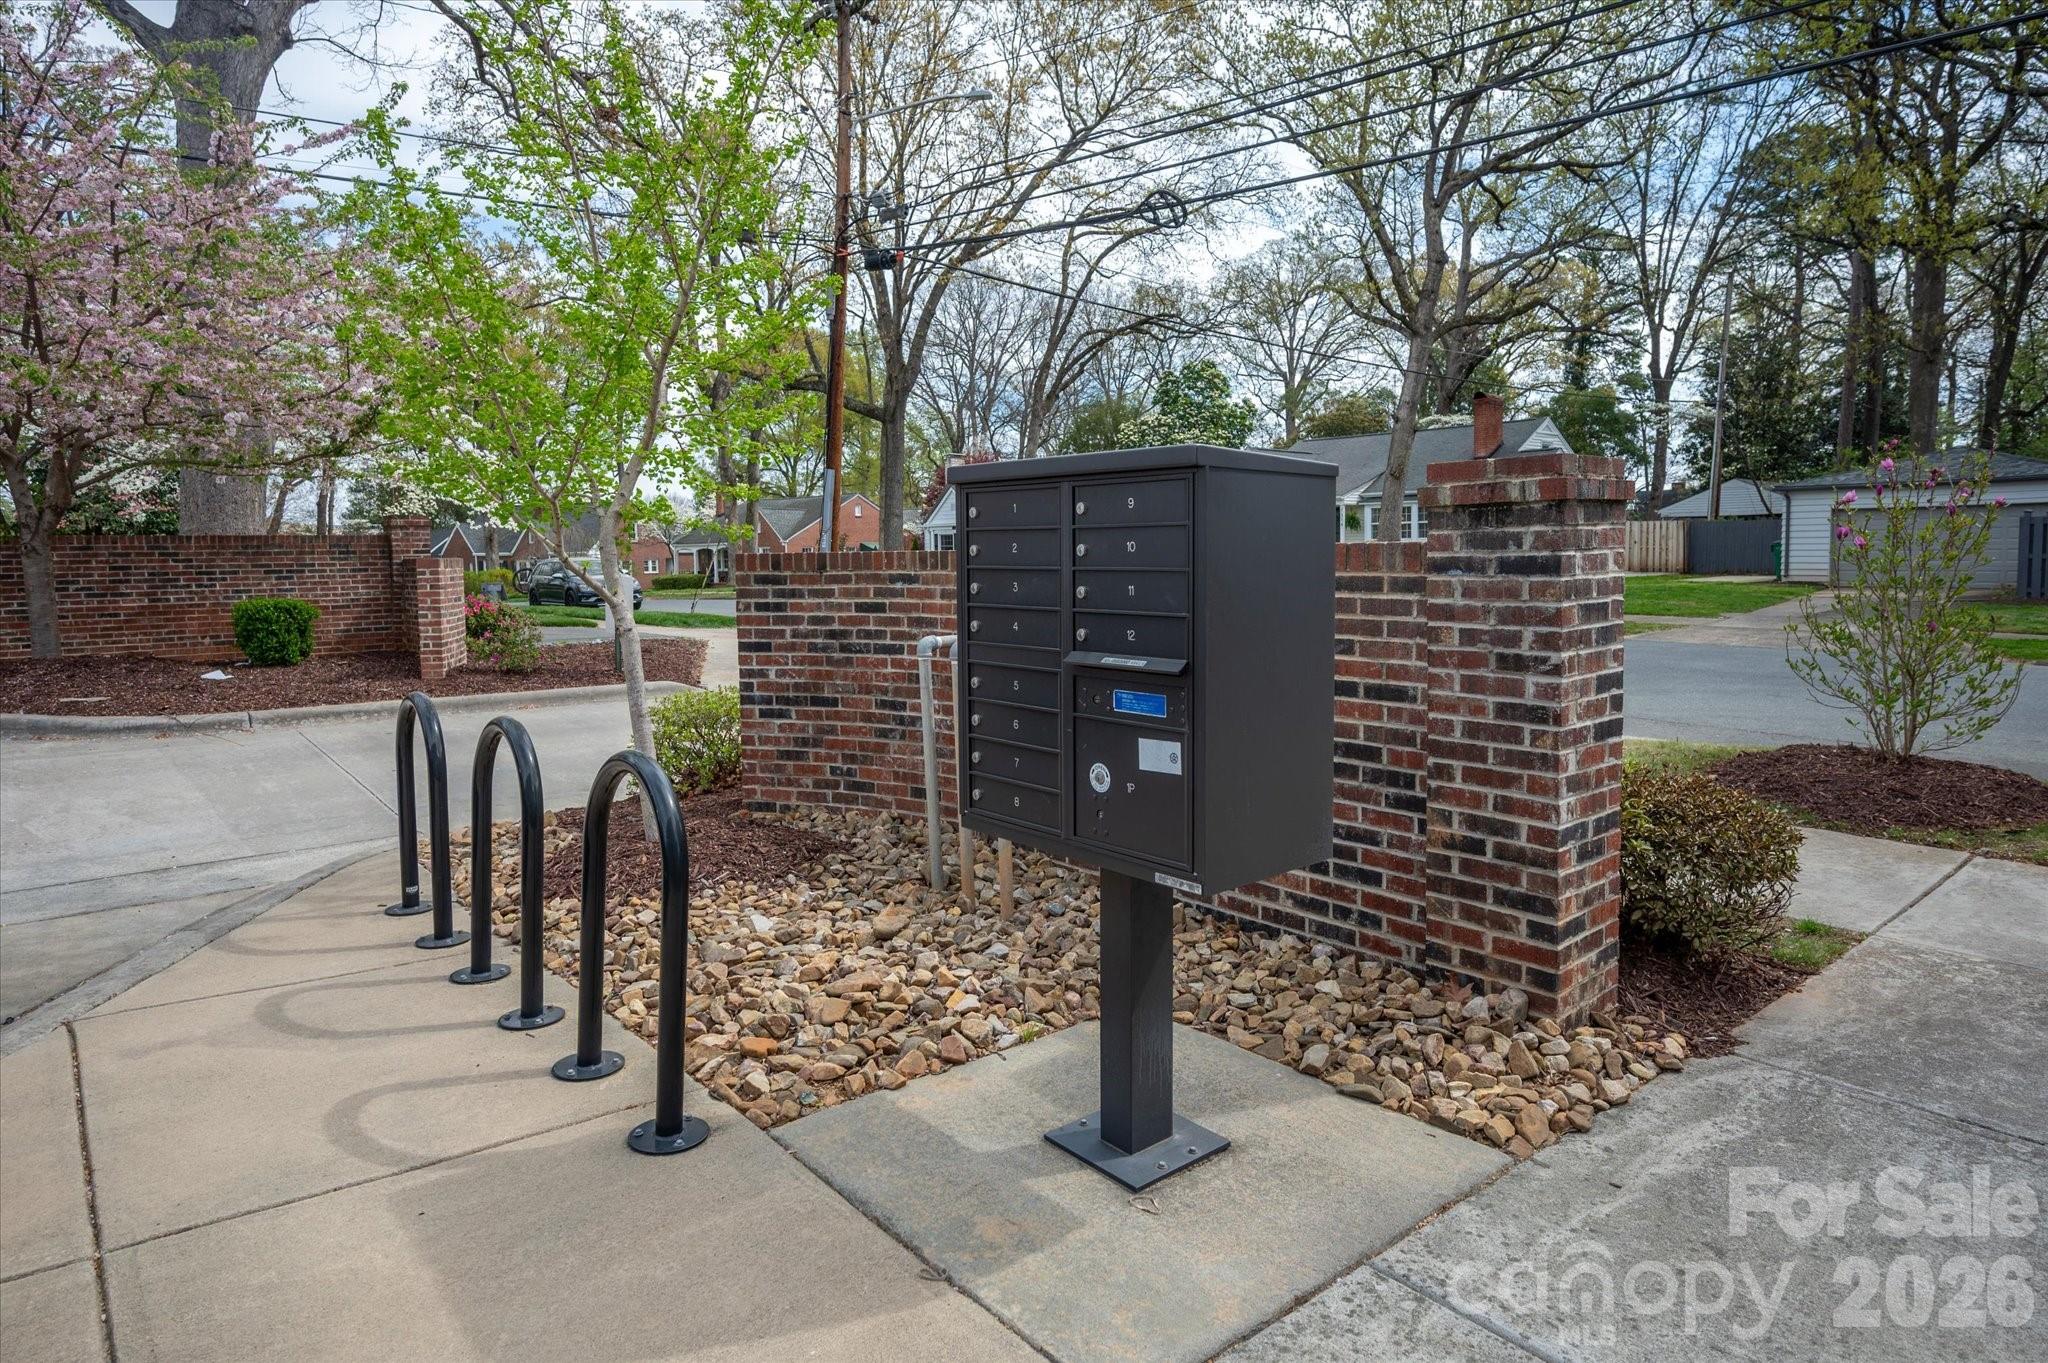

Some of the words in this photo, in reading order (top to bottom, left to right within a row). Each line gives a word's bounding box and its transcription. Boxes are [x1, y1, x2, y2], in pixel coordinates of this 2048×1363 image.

[1012, 503, 1017, 513] 1
[1127, 497, 1135, 509] 9
[1012, 542, 1018, 553] 2
[1126, 541, 1136, 552] 10
[1012, 582, 1018, 592] 3
[1128, 585, 1135, 596] 11
[1012, 621, 1019, 631] 4
[1126, 630, 1136, 641] 12
[1013, 680, 1019, 690] 5
[1013, 719, 1019, 729] 6
[1014, 758, 1020, 768] 7
[1013, 796, 1020, 807] 8
